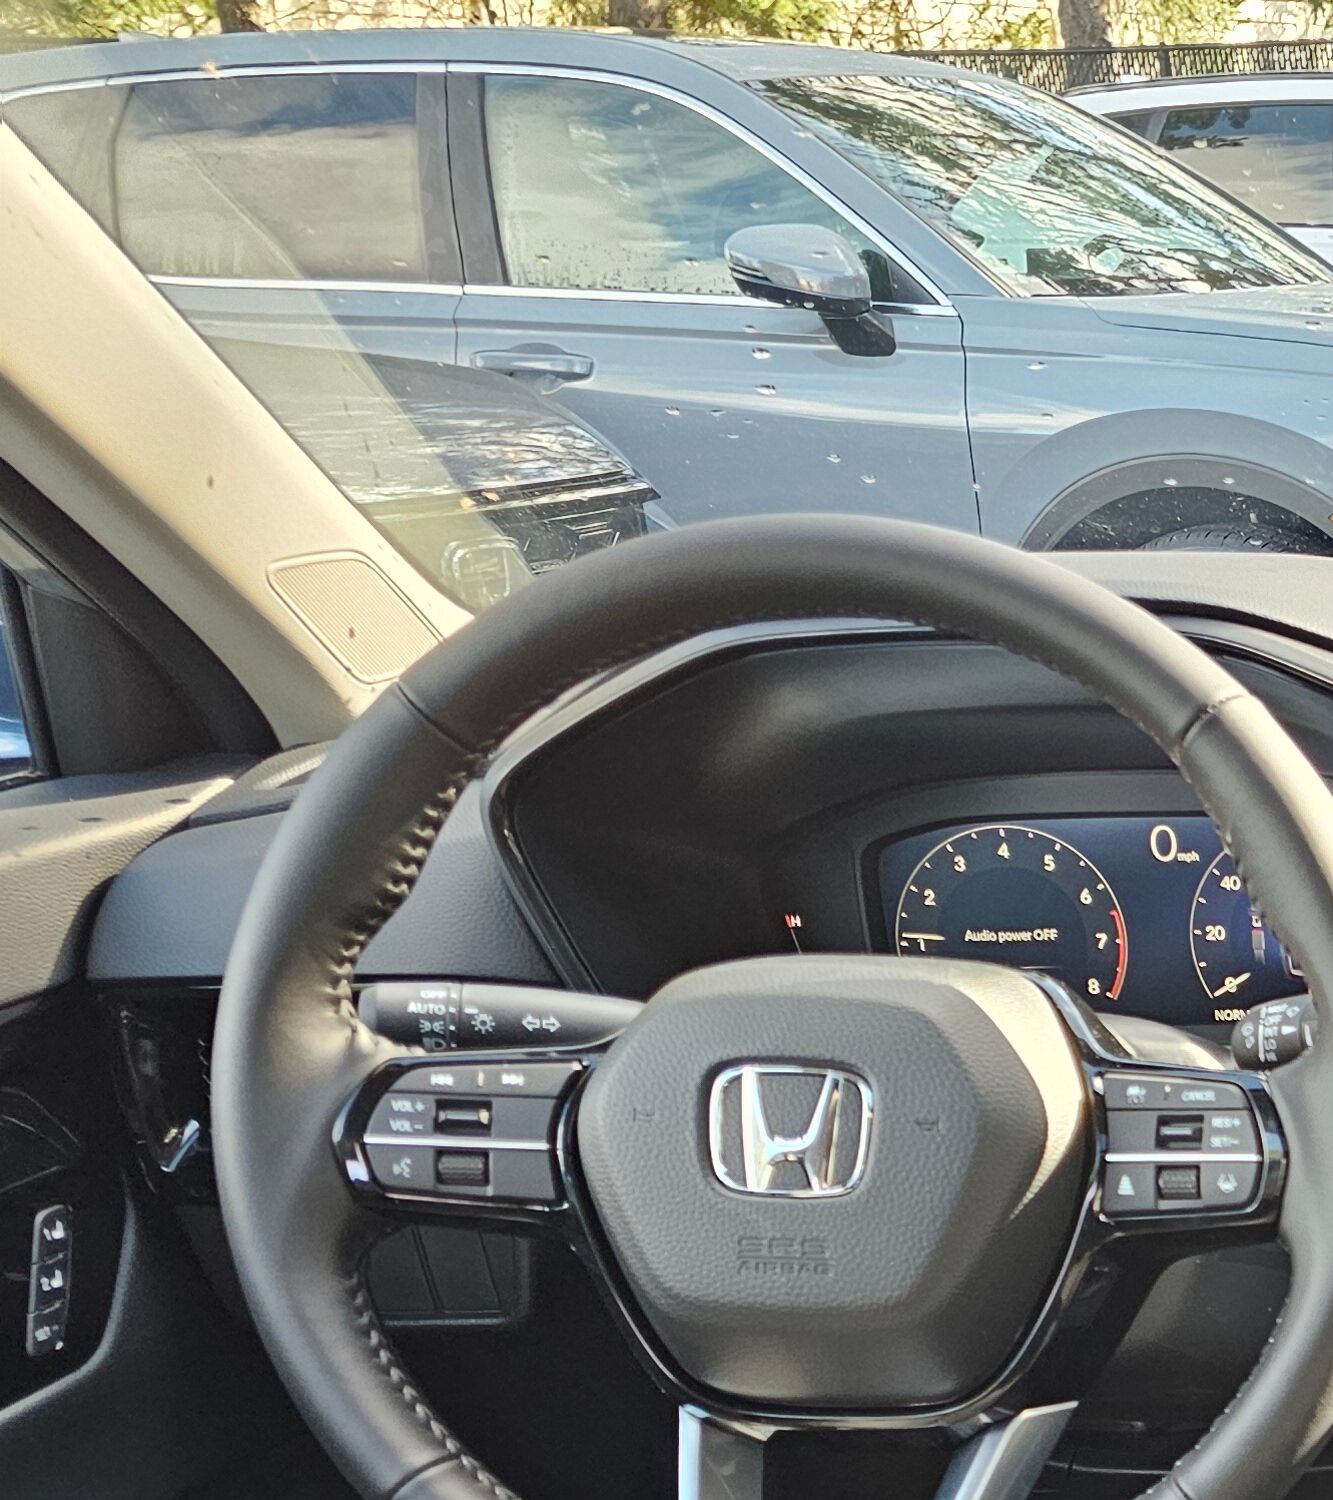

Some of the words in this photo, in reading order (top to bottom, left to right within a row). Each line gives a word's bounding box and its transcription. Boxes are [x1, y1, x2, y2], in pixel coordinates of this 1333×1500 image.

[997, 842, 1010, 859] 4
[1150, 824, 1177, 862] 0
[1177, 851, 1200, 863] mph
[953, 855, 966, 873] 3
[1043, 854, 1056, 872] 5
[1219, 876, 1241, 891] 40
[923, 889, 937, 906] 2
[1080, 888, 1093, 904] 6
[964, 929, 997, 942] Audio
[998, 930, 1032, 944] power
[1033, 928, 1058, 941] OFF
[1095, 932, 1108, 950] 7
[1205, 925, 1226, 941] 20
[1087, 978, 1100, 995] 8
[407, 1001, 446, 1015] AUTO
